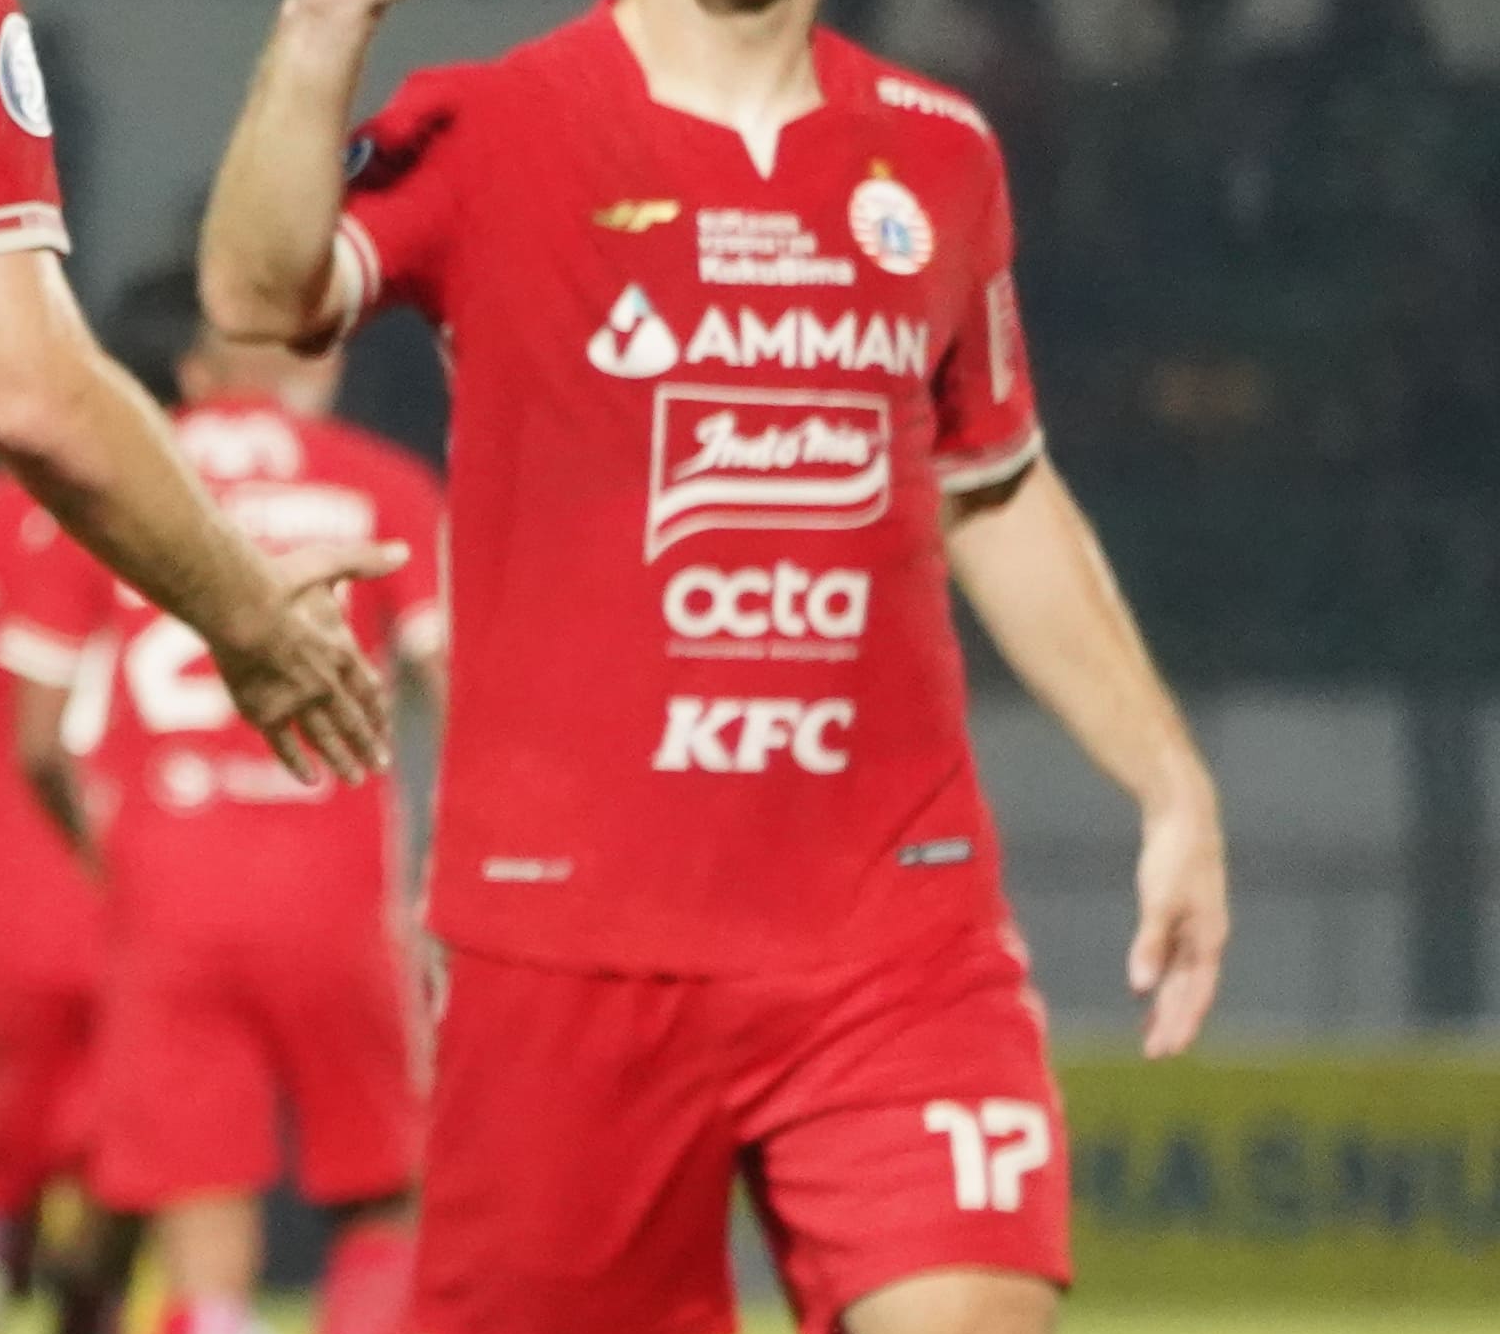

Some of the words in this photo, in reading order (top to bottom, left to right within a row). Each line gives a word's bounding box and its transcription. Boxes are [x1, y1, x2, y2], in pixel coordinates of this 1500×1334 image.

[684, 305, 929, 377] AMMAN
[663, 562, 871, 639] octa
[652, 695, 854, 775] KFC
